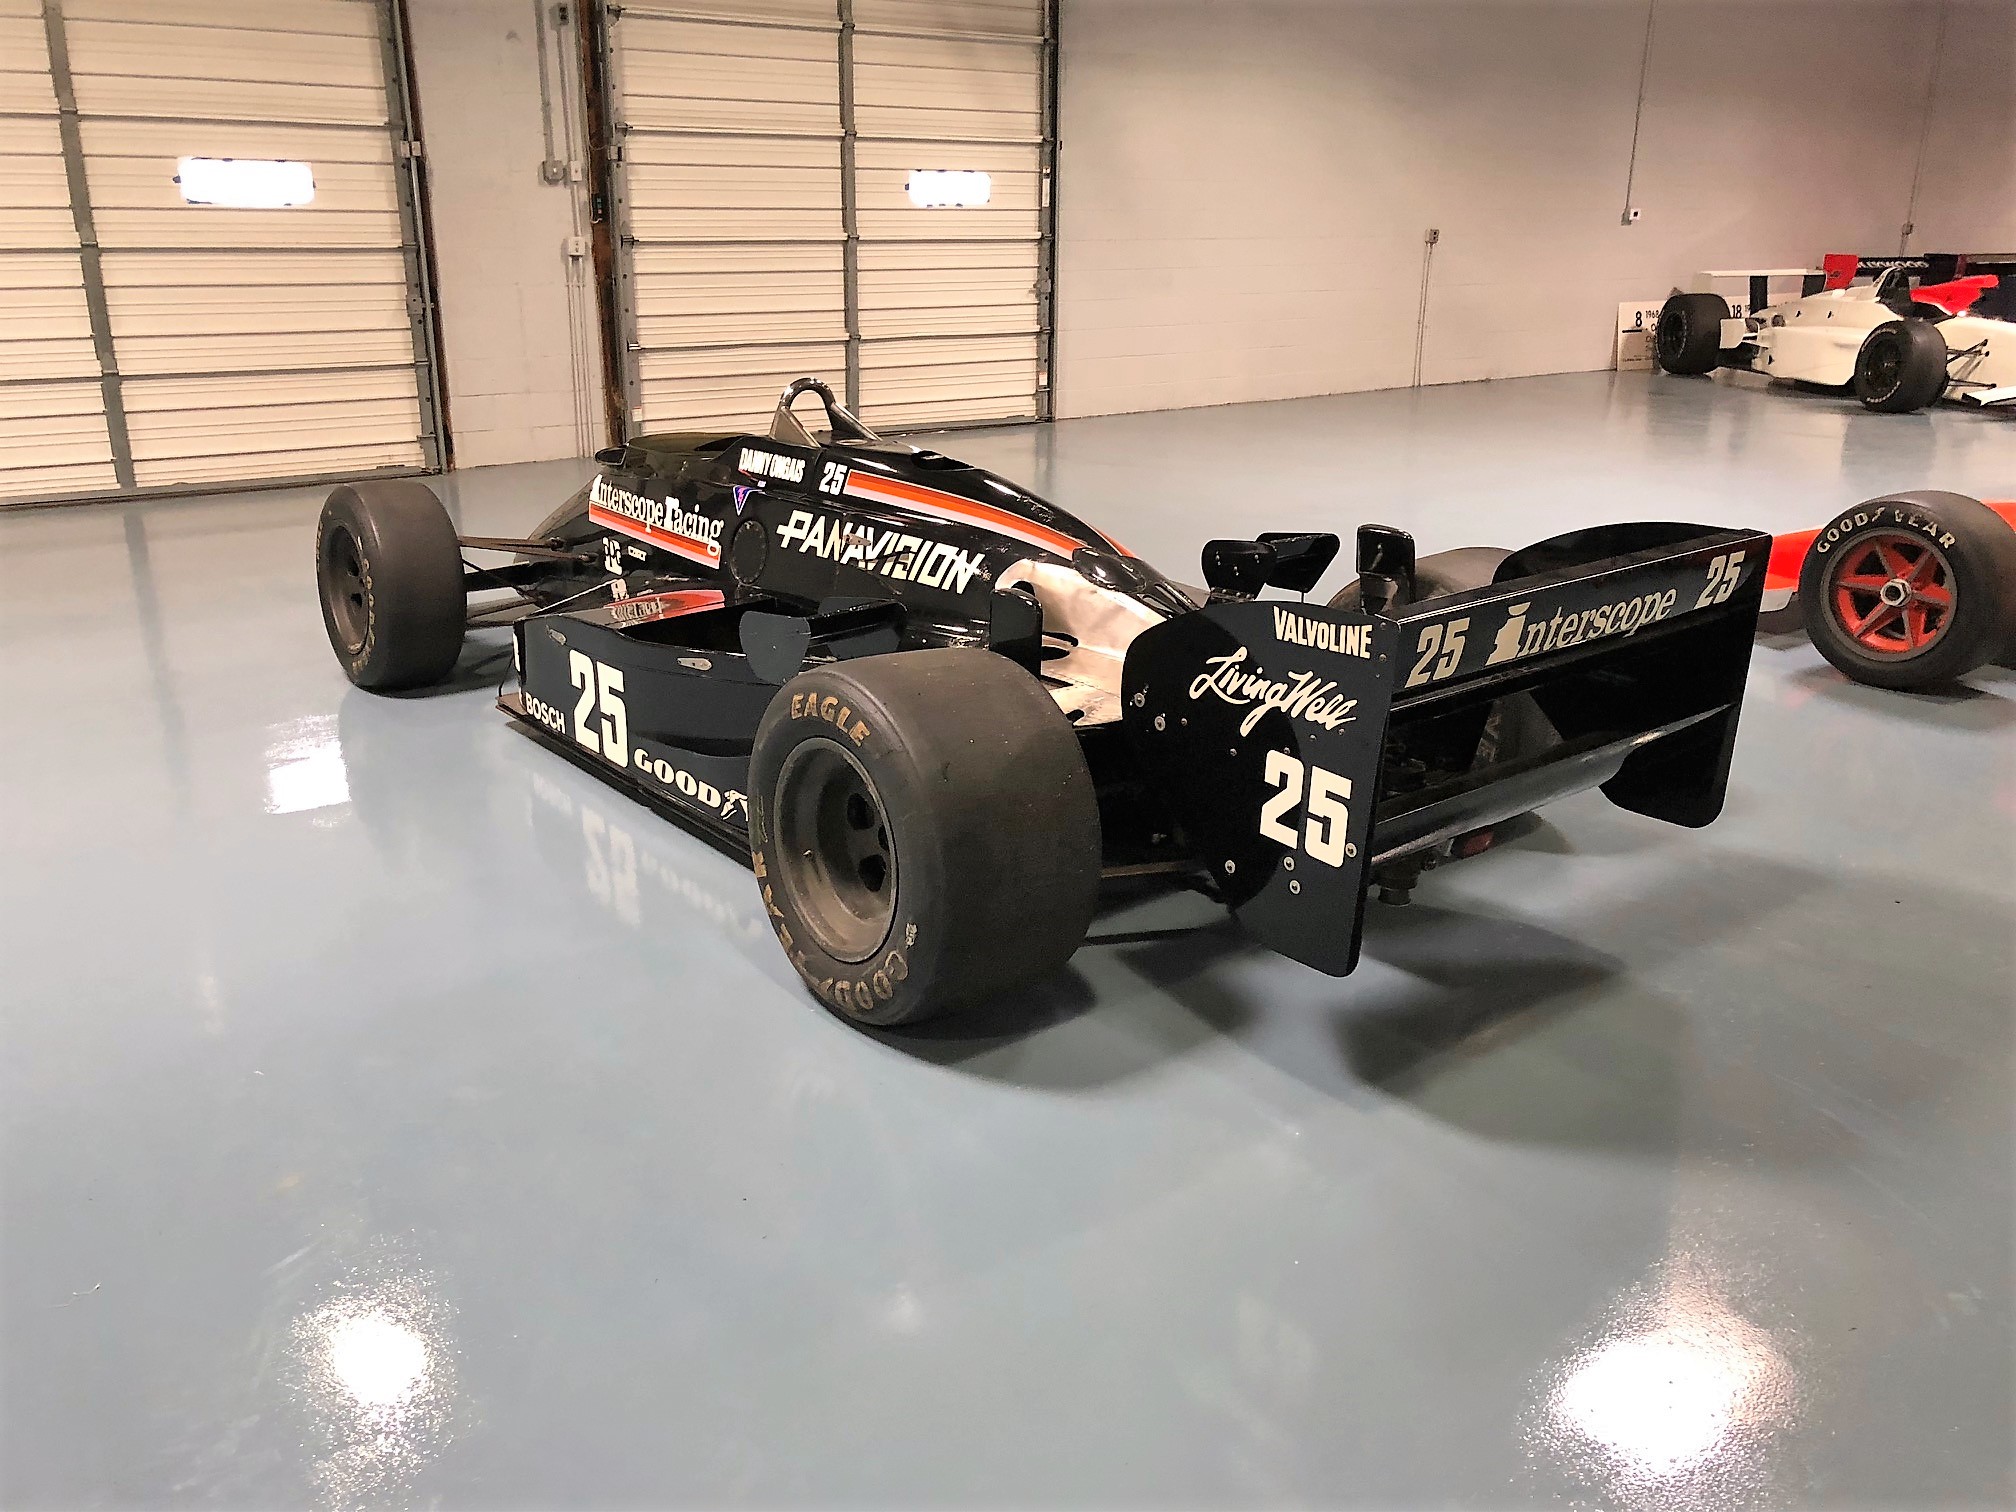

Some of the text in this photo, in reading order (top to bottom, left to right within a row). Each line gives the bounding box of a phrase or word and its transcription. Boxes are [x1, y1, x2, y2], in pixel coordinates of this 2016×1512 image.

[1635, 310, 1643, 328] 8
[1731, 304, 1742, 319] 18
[738, 447, 774, 476] DANNY
[818, 461, 848, 496] 25
[776, 509, 986, 595] PANAVISION
[1693, 550, 1746, 610] 25
[1273, 605, 1374, 660] VALVOLINE
[1404, 616, 1471, 689] 25
[525, 691, 566, 735] BOSCH
[568, 649, 629, 768] 25
[790, 692, 872, 748] EAGLE
[1188, 646, 1358, 738] Living Well
[1259, 749, 1353, 868] 25
